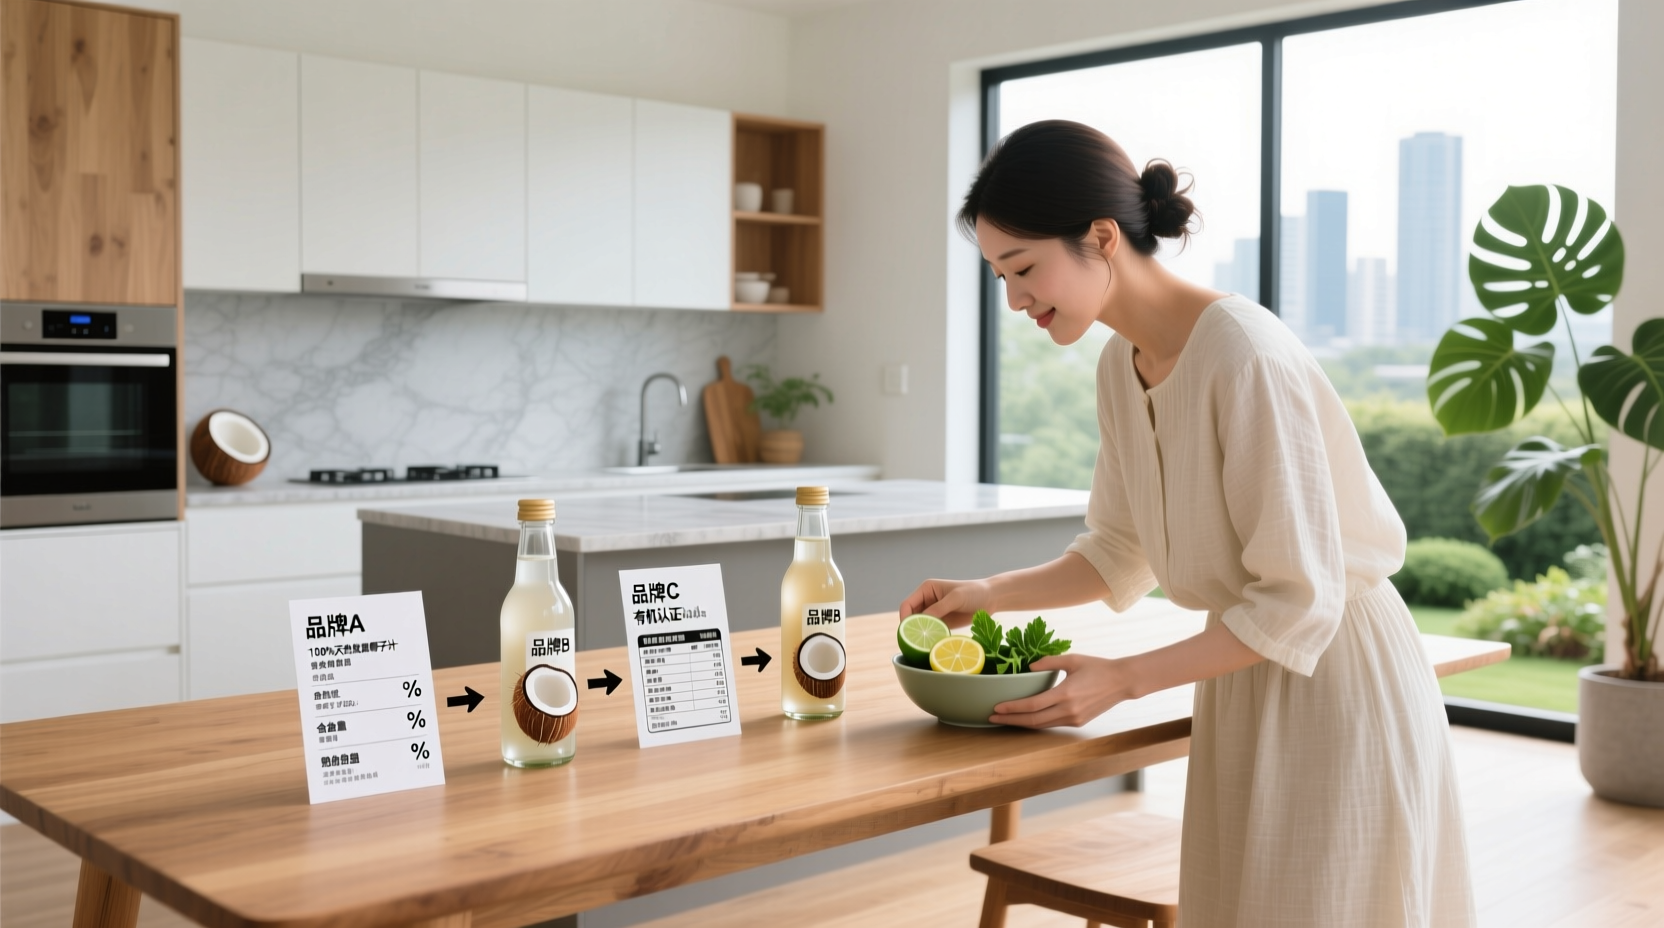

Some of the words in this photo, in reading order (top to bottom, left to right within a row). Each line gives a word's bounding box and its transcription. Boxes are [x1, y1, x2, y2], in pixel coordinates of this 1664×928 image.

[632, 582, 680, 605] 品牌C
[306, 613, 365, 639] 品牌A
[806, 608, 841, 626] 品牌B
[531, 637, 570, 657] 品牌B
[402, 680, 422, 698] %
[407, 709, 426, 730] %
[410, 741, 430, 761] %
